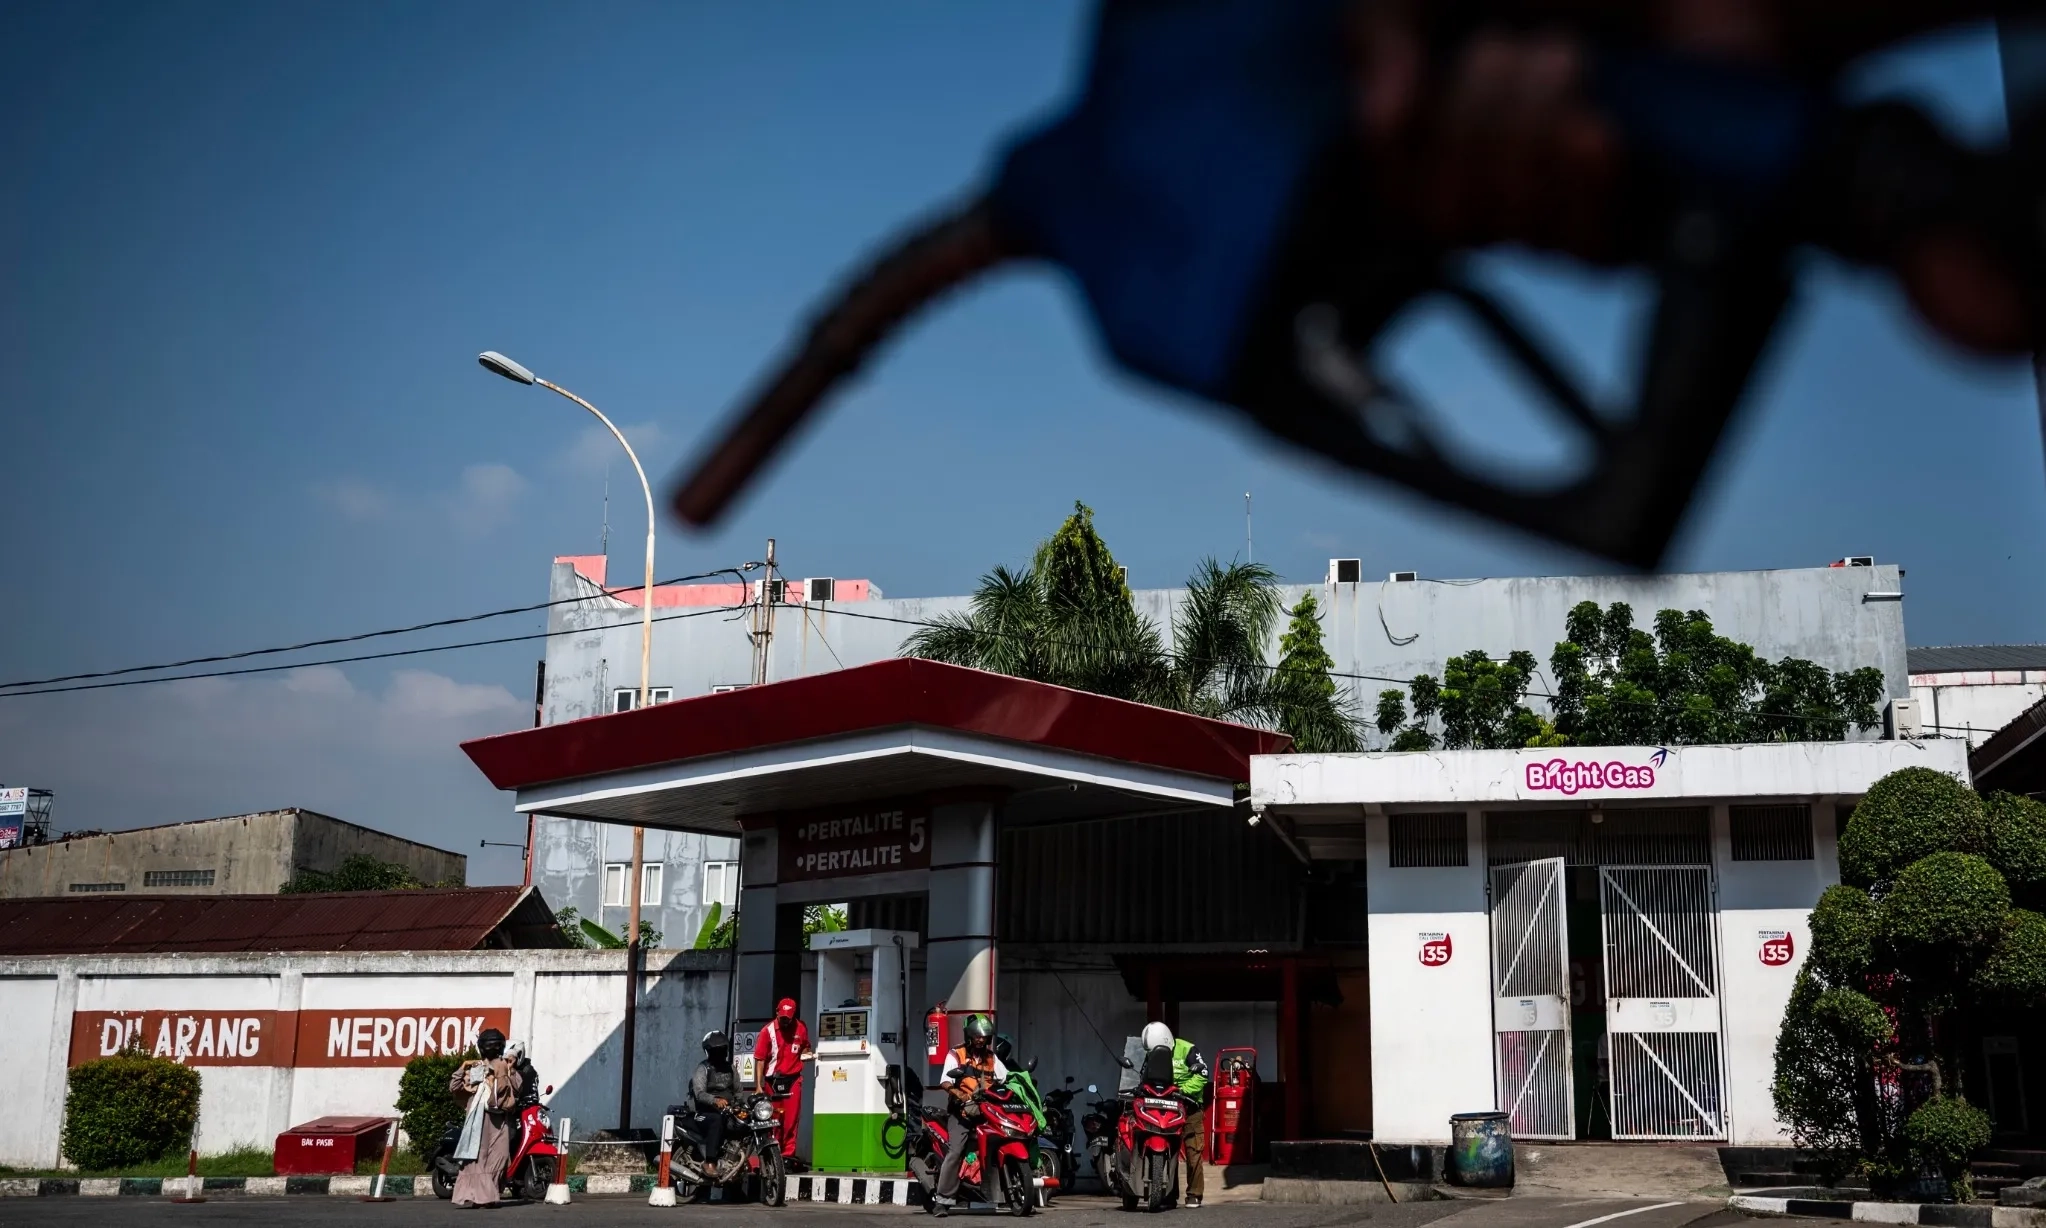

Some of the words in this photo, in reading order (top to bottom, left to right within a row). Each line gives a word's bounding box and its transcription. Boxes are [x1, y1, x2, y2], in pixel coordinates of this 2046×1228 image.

[1527, 760, 1603, 794] Bright
[1605, 762, 1654, 788] Gas
[808, 810, 903, 841] PERTALITE
[909, 817, 926, 853] 5
[806, 844, 902, 872] PERTALITE
[327, 1016, 485, 1058] MEROKOK
[301, 1138, 313, 1147] BAK
[316, 1138, 334, 1147] PASIR
